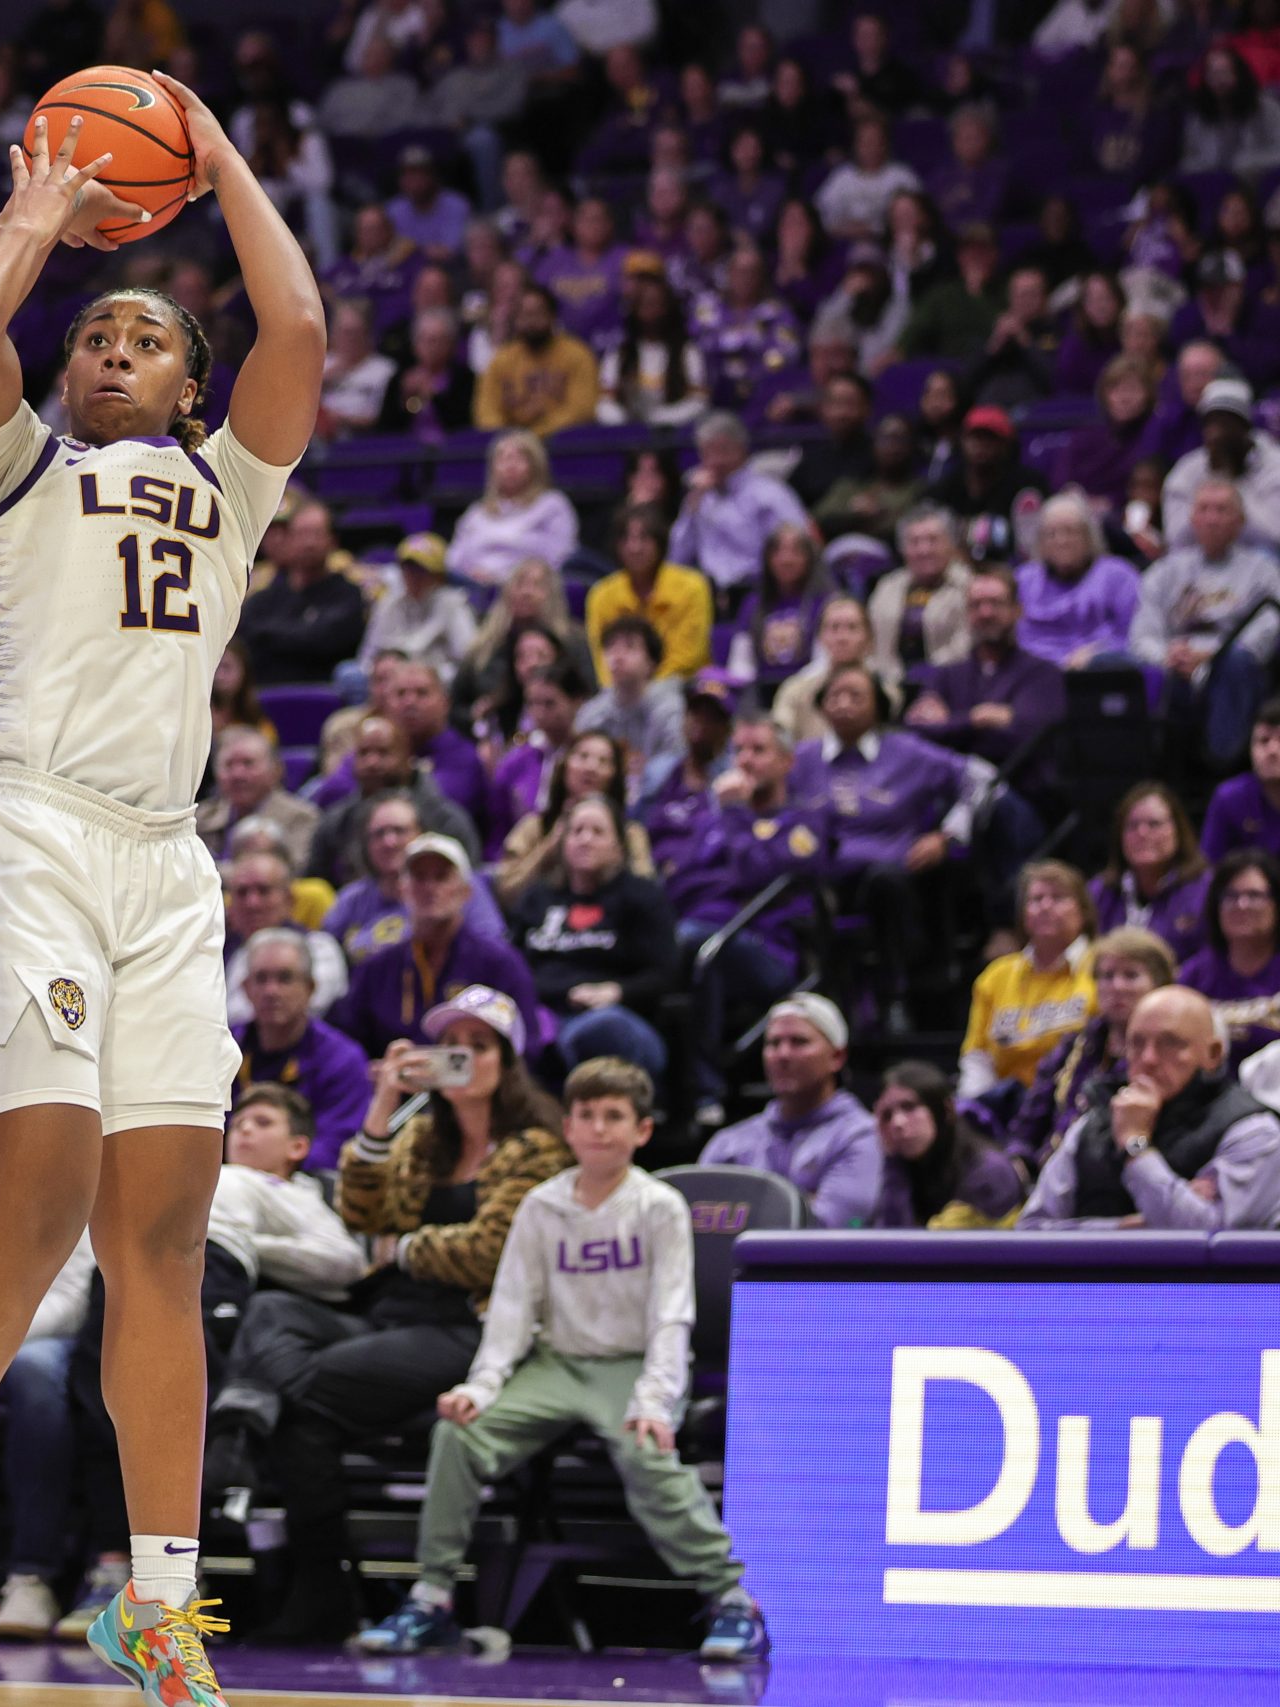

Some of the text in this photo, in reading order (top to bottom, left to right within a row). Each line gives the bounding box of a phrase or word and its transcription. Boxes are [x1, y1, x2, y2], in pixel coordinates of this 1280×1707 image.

[79, 472, 221, 541] LSU
[117, 532, 201, 635] 12
[691, 1201, 750, 1234] SU
[557, 1234, 643, 1274] LSU
[885, 1345, 1280, 1557] Dud
